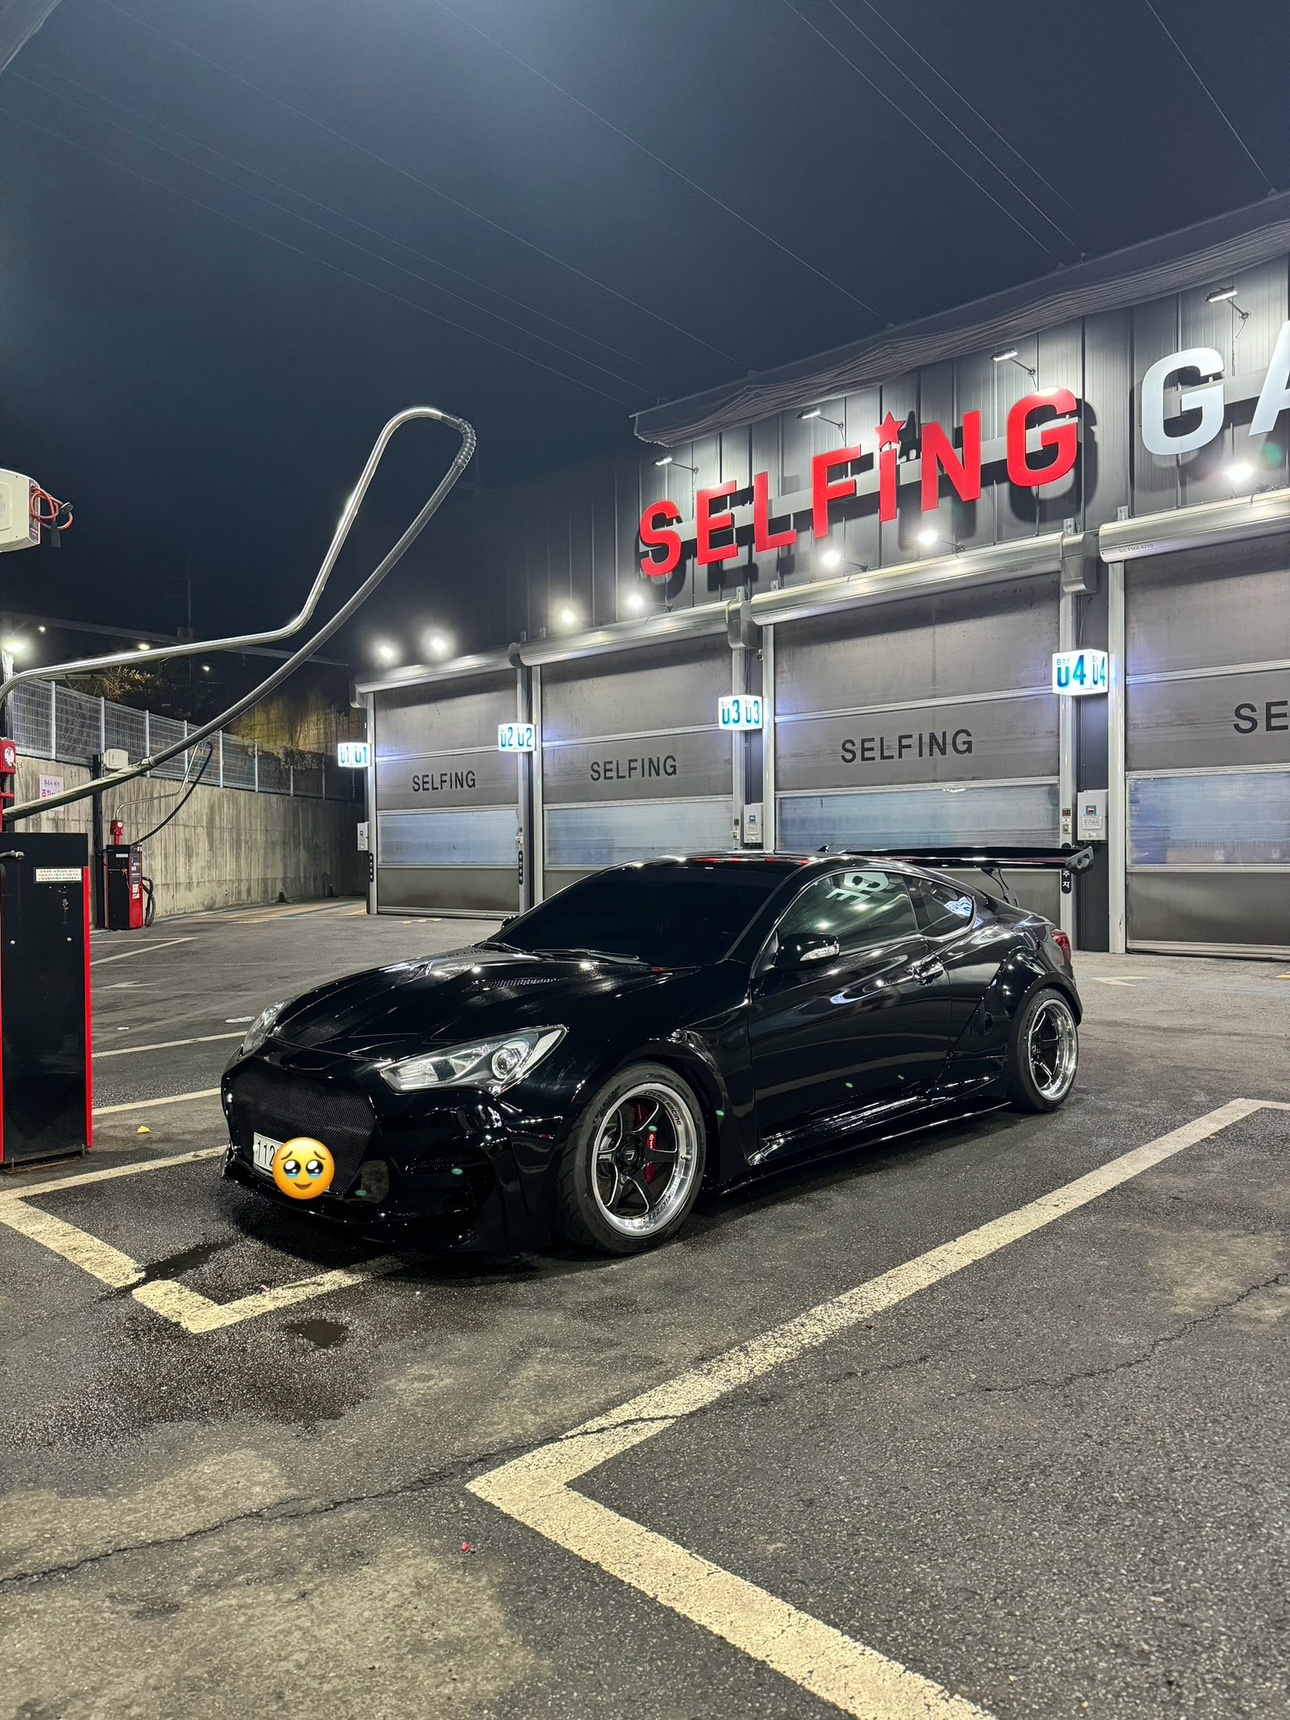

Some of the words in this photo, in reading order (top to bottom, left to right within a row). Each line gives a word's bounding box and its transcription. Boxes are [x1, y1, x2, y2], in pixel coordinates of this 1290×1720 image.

[841, 728, 973, 763] SELFING
[412, 770, 476, 792] SELFING
[590, 755, 677, 781] SELFING
